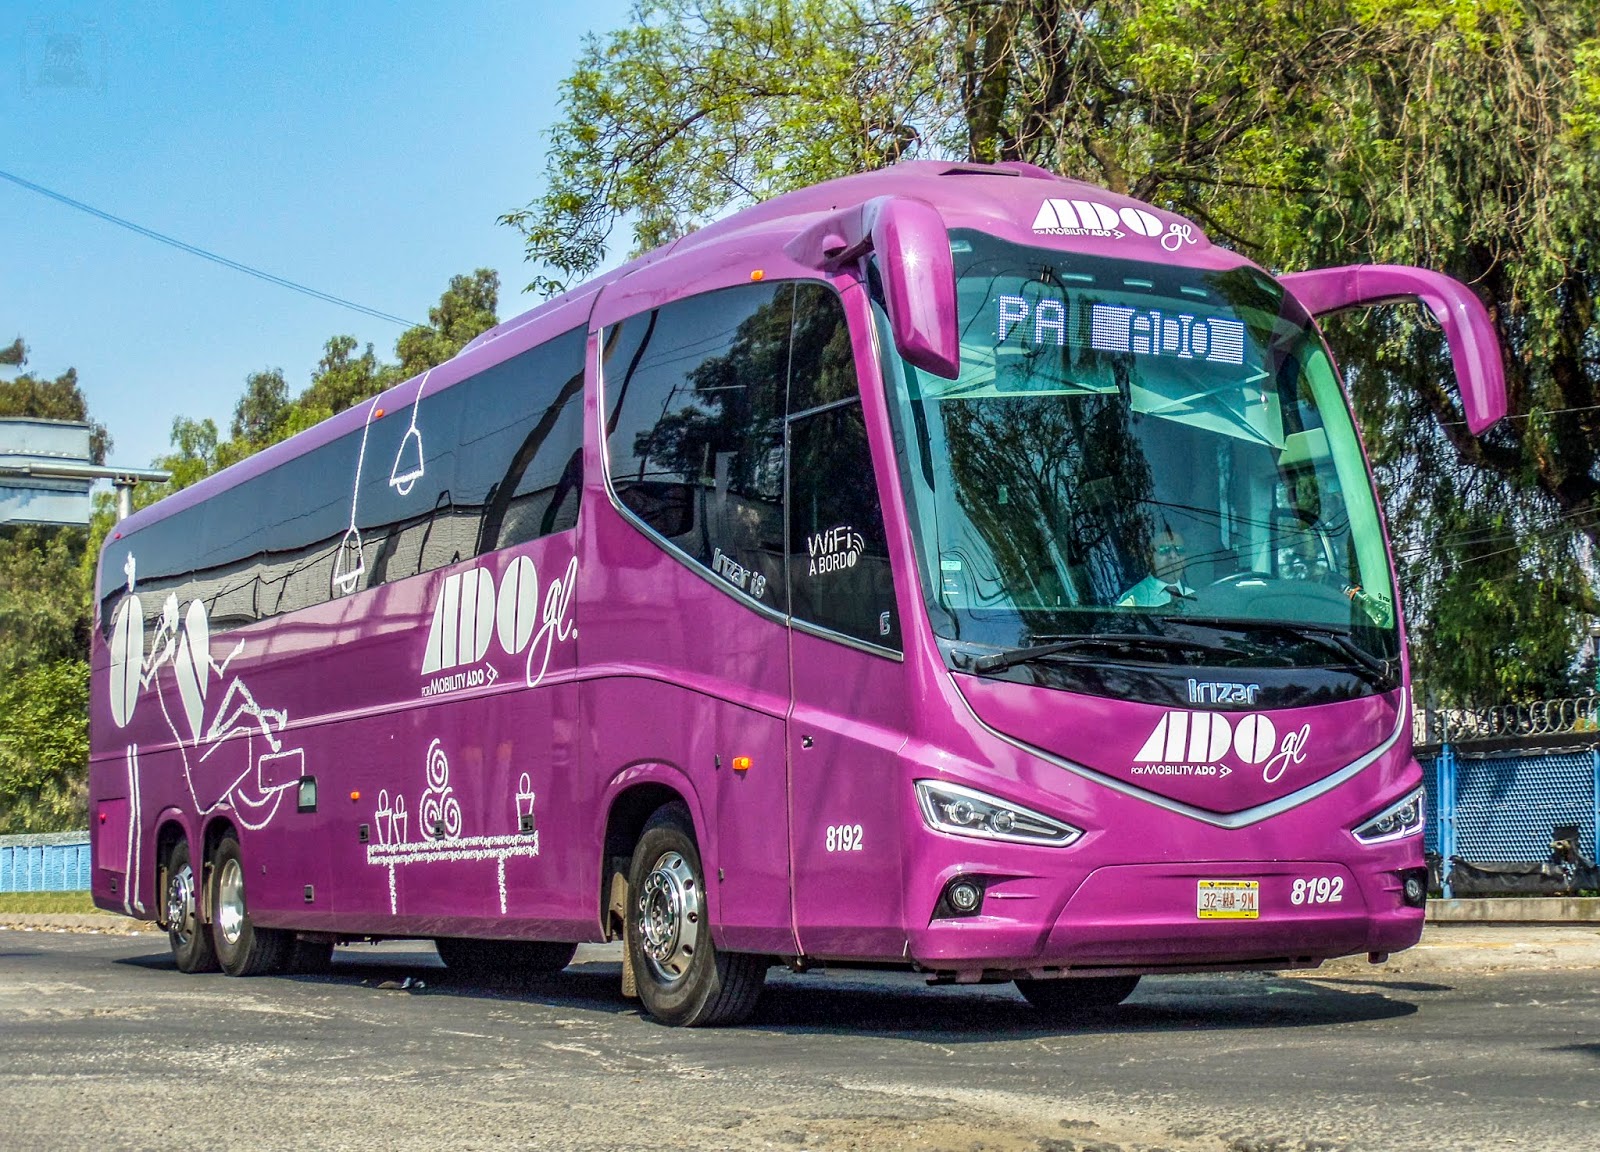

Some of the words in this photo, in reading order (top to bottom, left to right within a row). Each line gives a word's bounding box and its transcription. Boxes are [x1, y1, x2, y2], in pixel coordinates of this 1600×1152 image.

[1032, 199, 1164, 237] ADO
[1045, 228, 1089, 236] MOBILITY
[1091, 229, 1112, 237] ADO
[999, 296, 1065, 346] PA
[807, 526, 852, 557] WiFi
[809, 559, 818, 577] A
[819, 550, 857, 574] BORDO
[421, 555, 539, 676] ADO
[430, 672, 466, 695] MOBILITY
[466, 668, 485, 688] ADO
[1188, 679, 1260, 705] Irizar
[1132, 711, 1276, 764] ADO
[1143, 764, 1194, 775] MOBILITY
[1194, 765, 1217, 776] ADO
[826, 824, 863, 853] 8192
[1290, 876, 1344, 905] 8192
